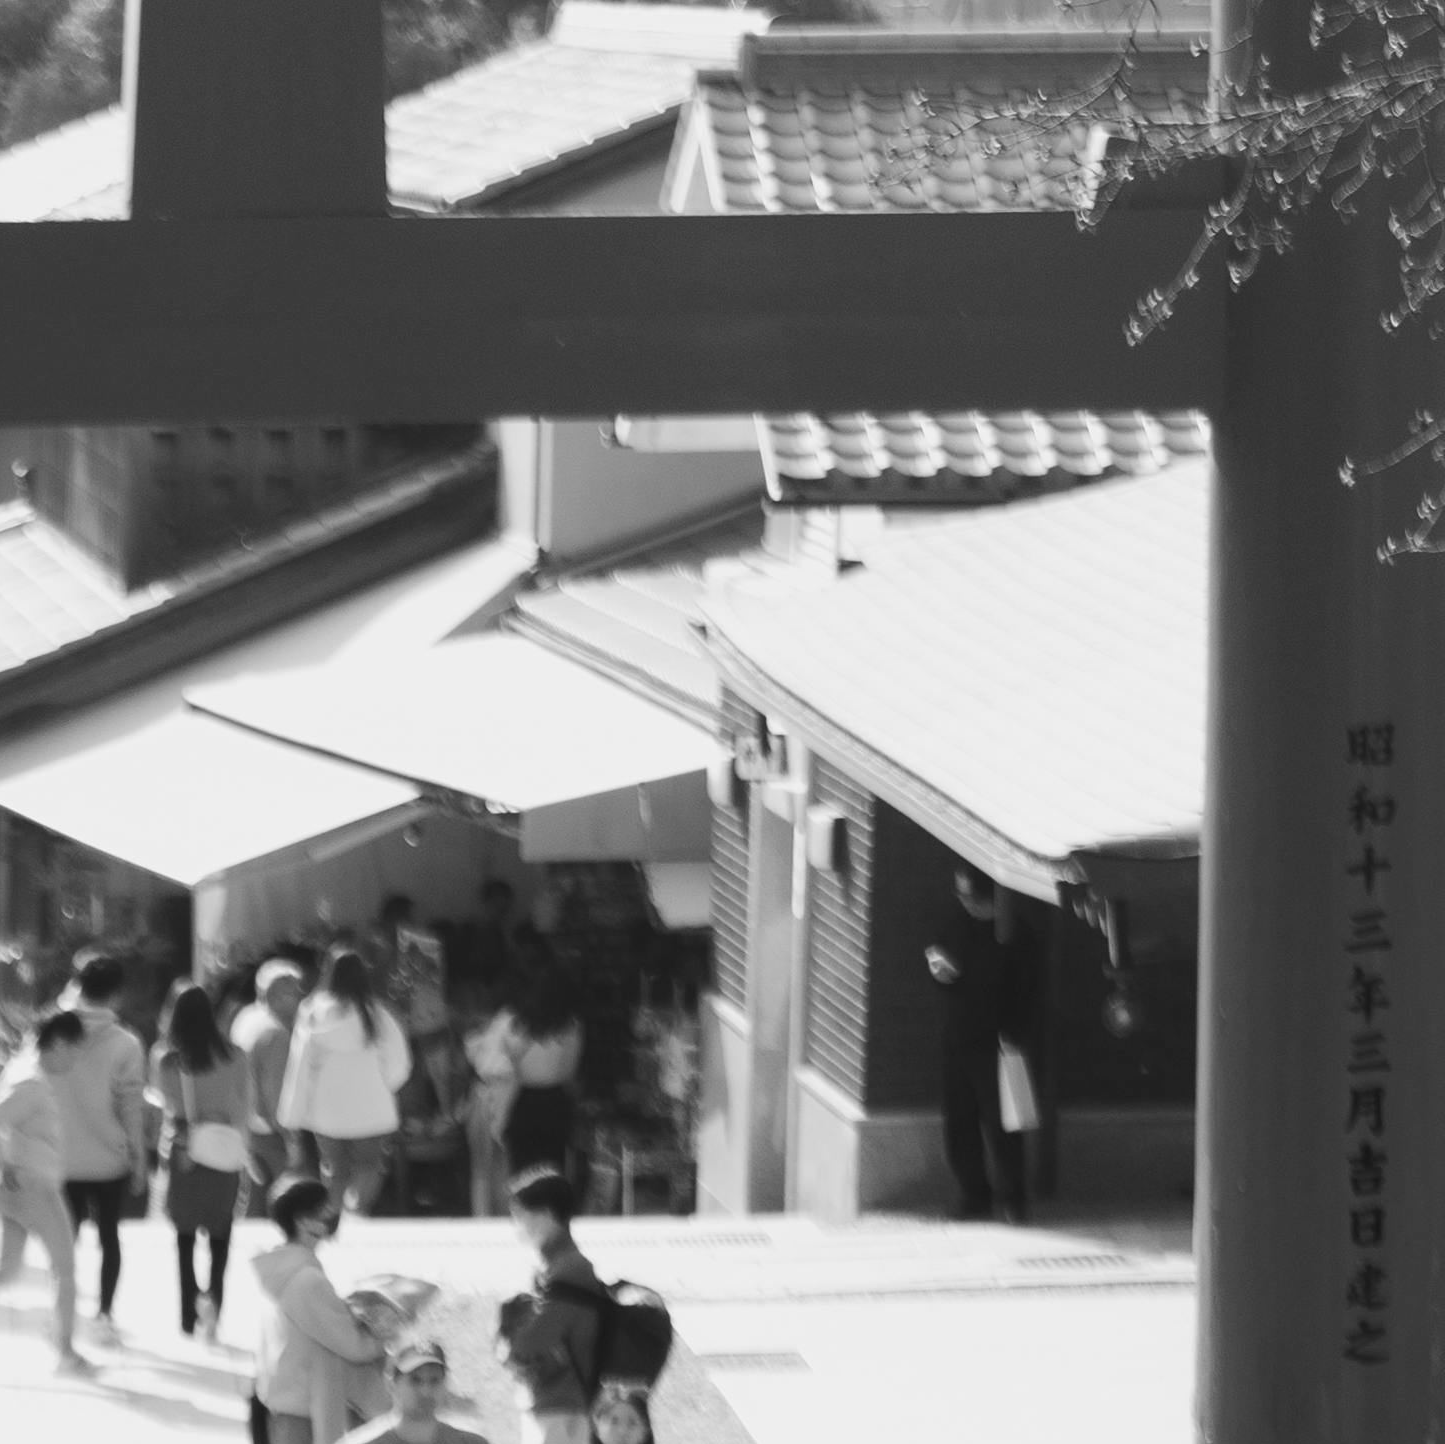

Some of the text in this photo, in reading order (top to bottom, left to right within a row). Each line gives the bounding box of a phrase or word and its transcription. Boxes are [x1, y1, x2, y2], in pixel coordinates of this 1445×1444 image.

[1344, 722, 1398, 1366] 昭和十三年三月吉日建之
